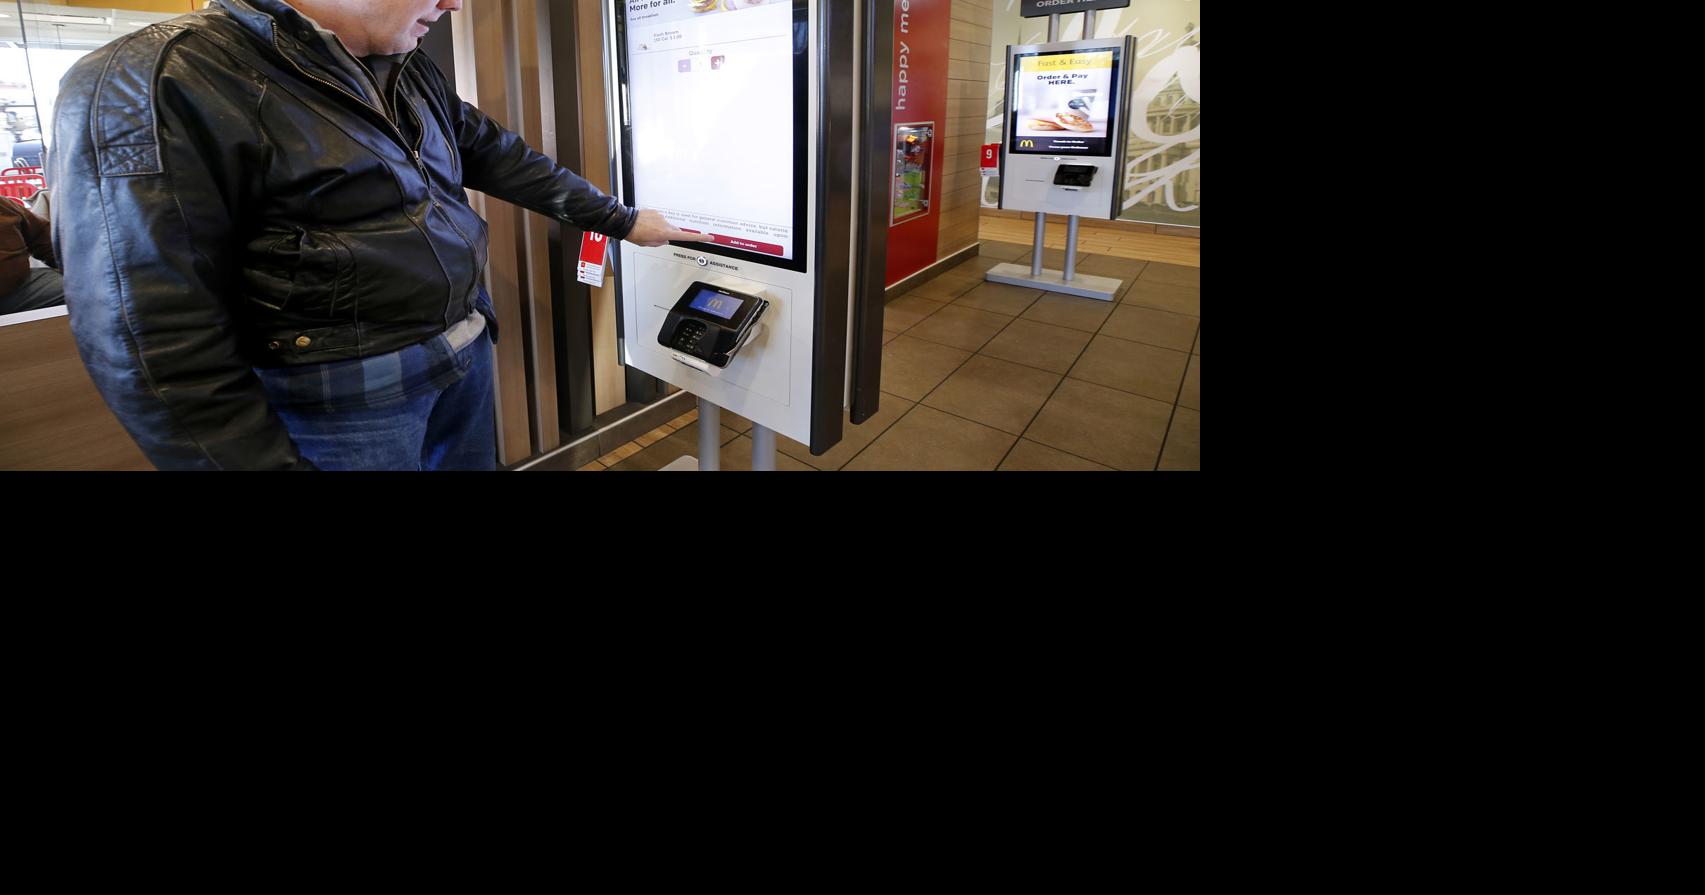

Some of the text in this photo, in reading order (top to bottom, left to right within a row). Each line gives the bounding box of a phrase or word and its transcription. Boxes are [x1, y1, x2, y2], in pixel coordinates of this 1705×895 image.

[629, 4, 648, 12] More
[650, 0, 661, 8] for
[1037, 59, 1056, 67] Fast
[1070, 58, 1093, 66] Easy
[895, 41, 910, 110] happy
[985, 148, 993, 159] 9
[709, 260, 740, 271] ASSISTANCE
